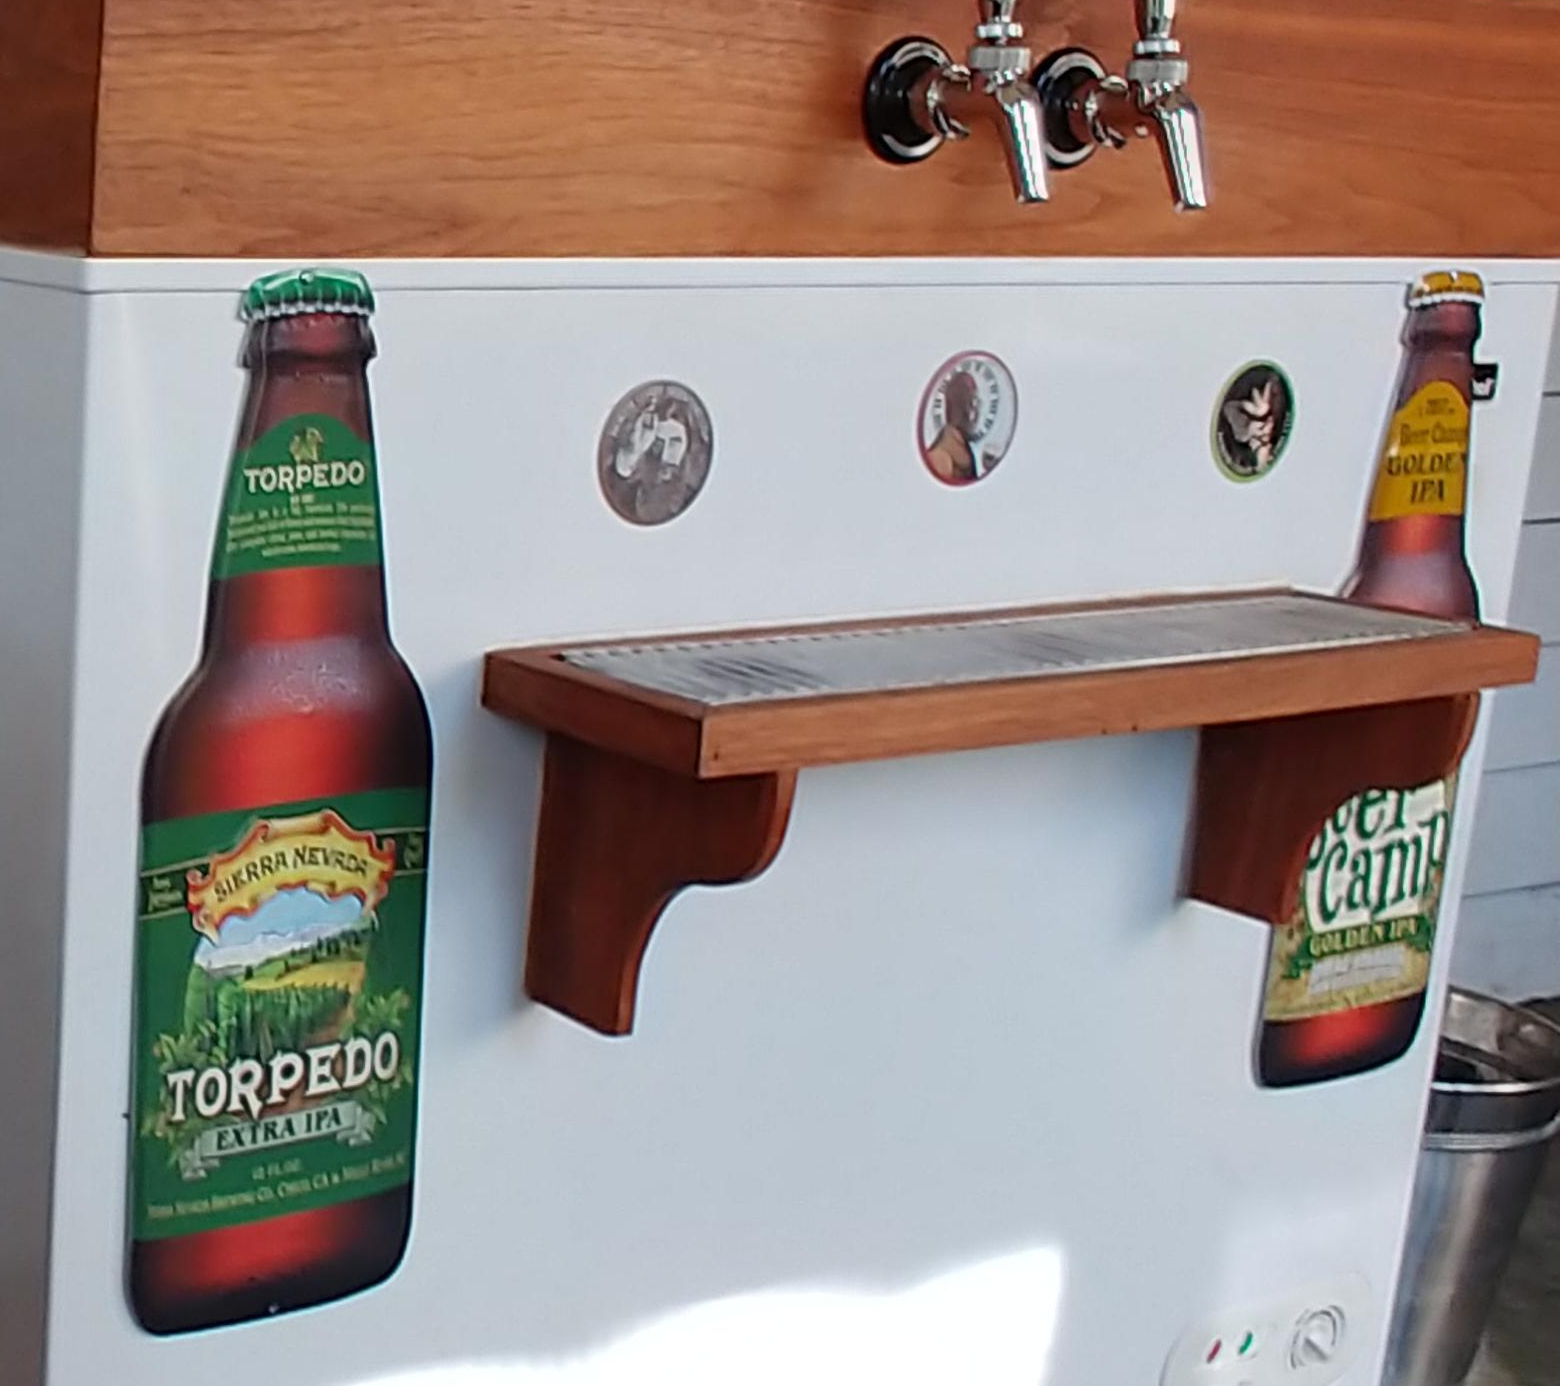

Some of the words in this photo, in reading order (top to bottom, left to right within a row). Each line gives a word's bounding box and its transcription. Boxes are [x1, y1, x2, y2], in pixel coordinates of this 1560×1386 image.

[243, 460, 366, 494] TORPEDO
[1410, 479, 1445, 506] IPA
[213, 854, 288, 904] SIERRA
[292, 844, 369, 878] NEVADA
[1309, 924, 1384, 958] GOLDEN
[166, 1031, 400, 1123] TORPEDO
[216, 1115, 296, 1152] EXTRA
[304, 1105, 343, 1135] IPA
